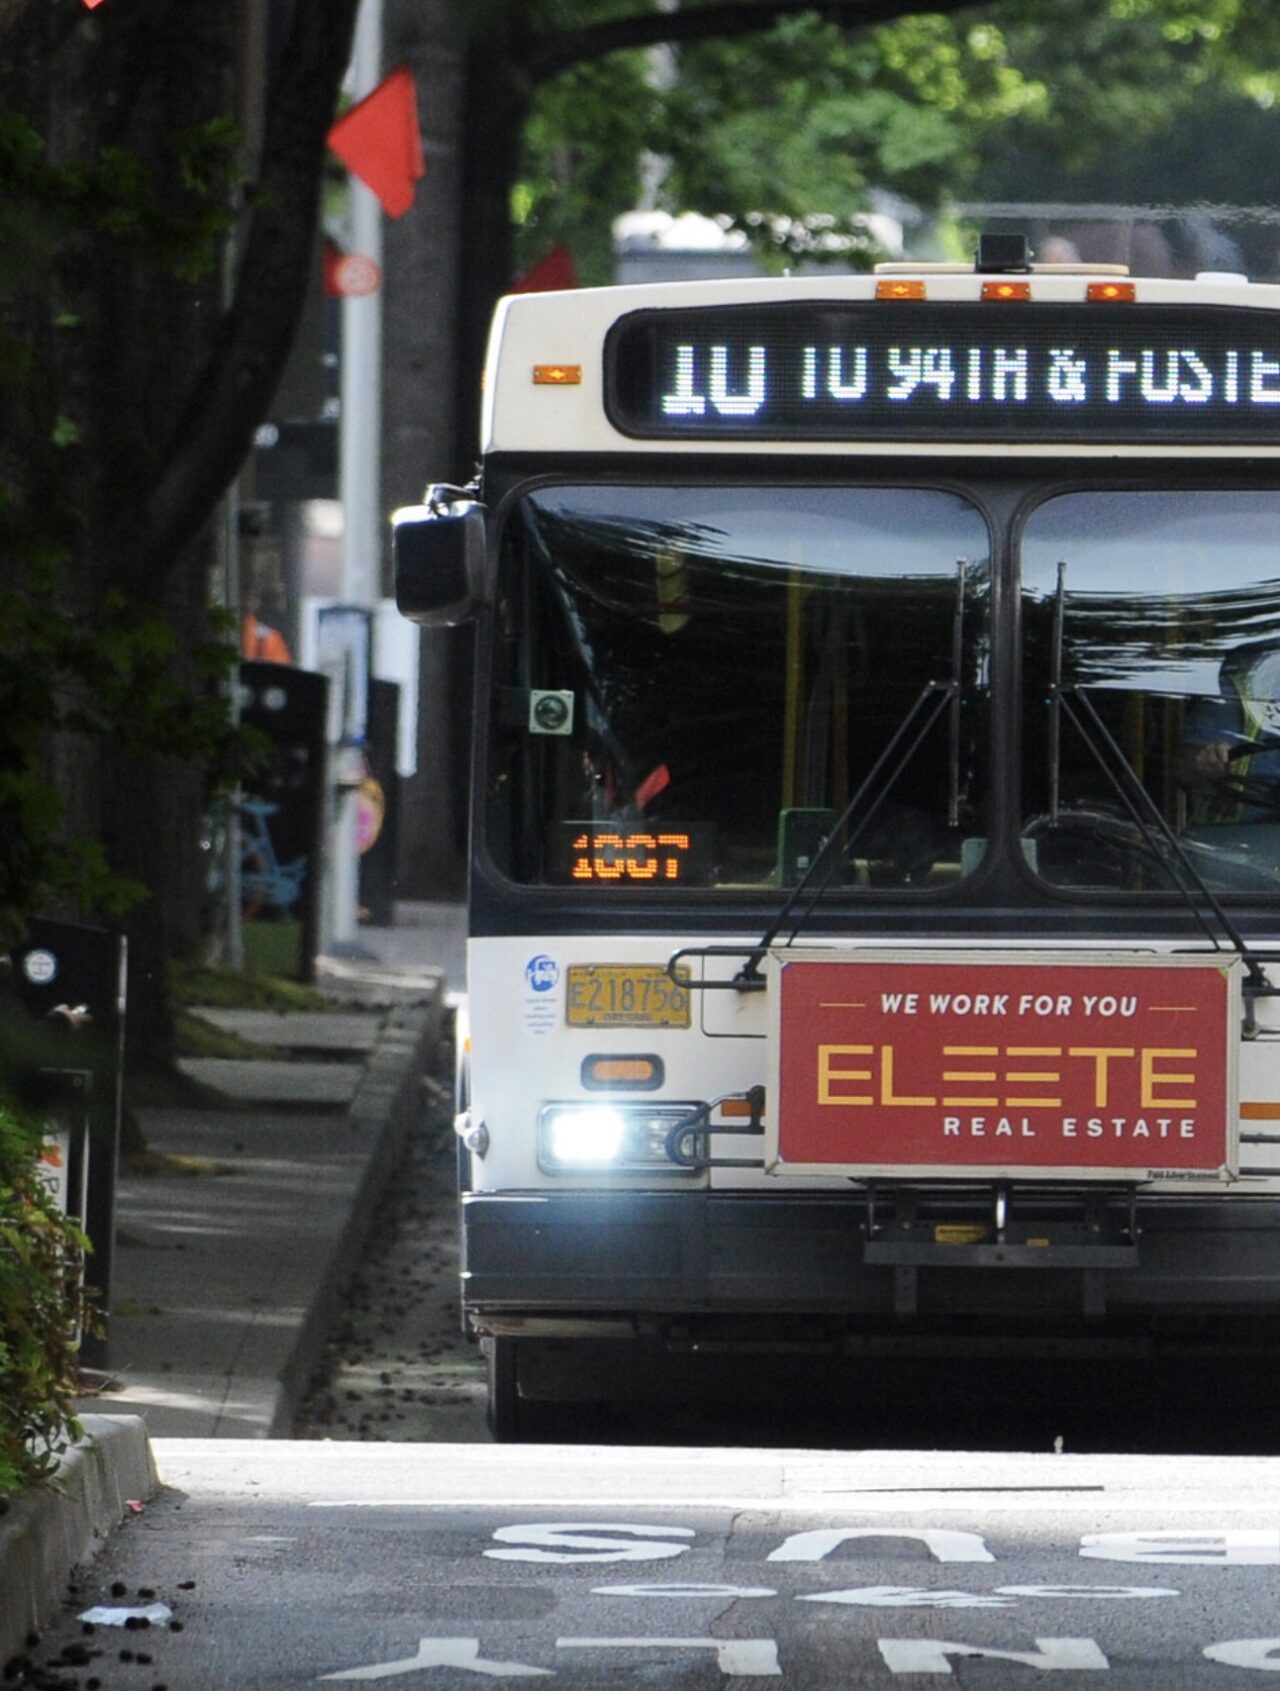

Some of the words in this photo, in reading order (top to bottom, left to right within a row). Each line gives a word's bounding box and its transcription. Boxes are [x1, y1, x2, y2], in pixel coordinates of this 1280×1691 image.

[881, 993, 919, 1014] WE
[929, 994, 1009, 1016] WORK
[1018, 995, 1072, 1017] FOR
[1082, 996, 1138, 1017] YOU
[817, 1045, 1198, 1109] ELEETE
[943, 1117, 1036, 1137] REAL
[1063, 1118, 1195, 1138] ESTATE
